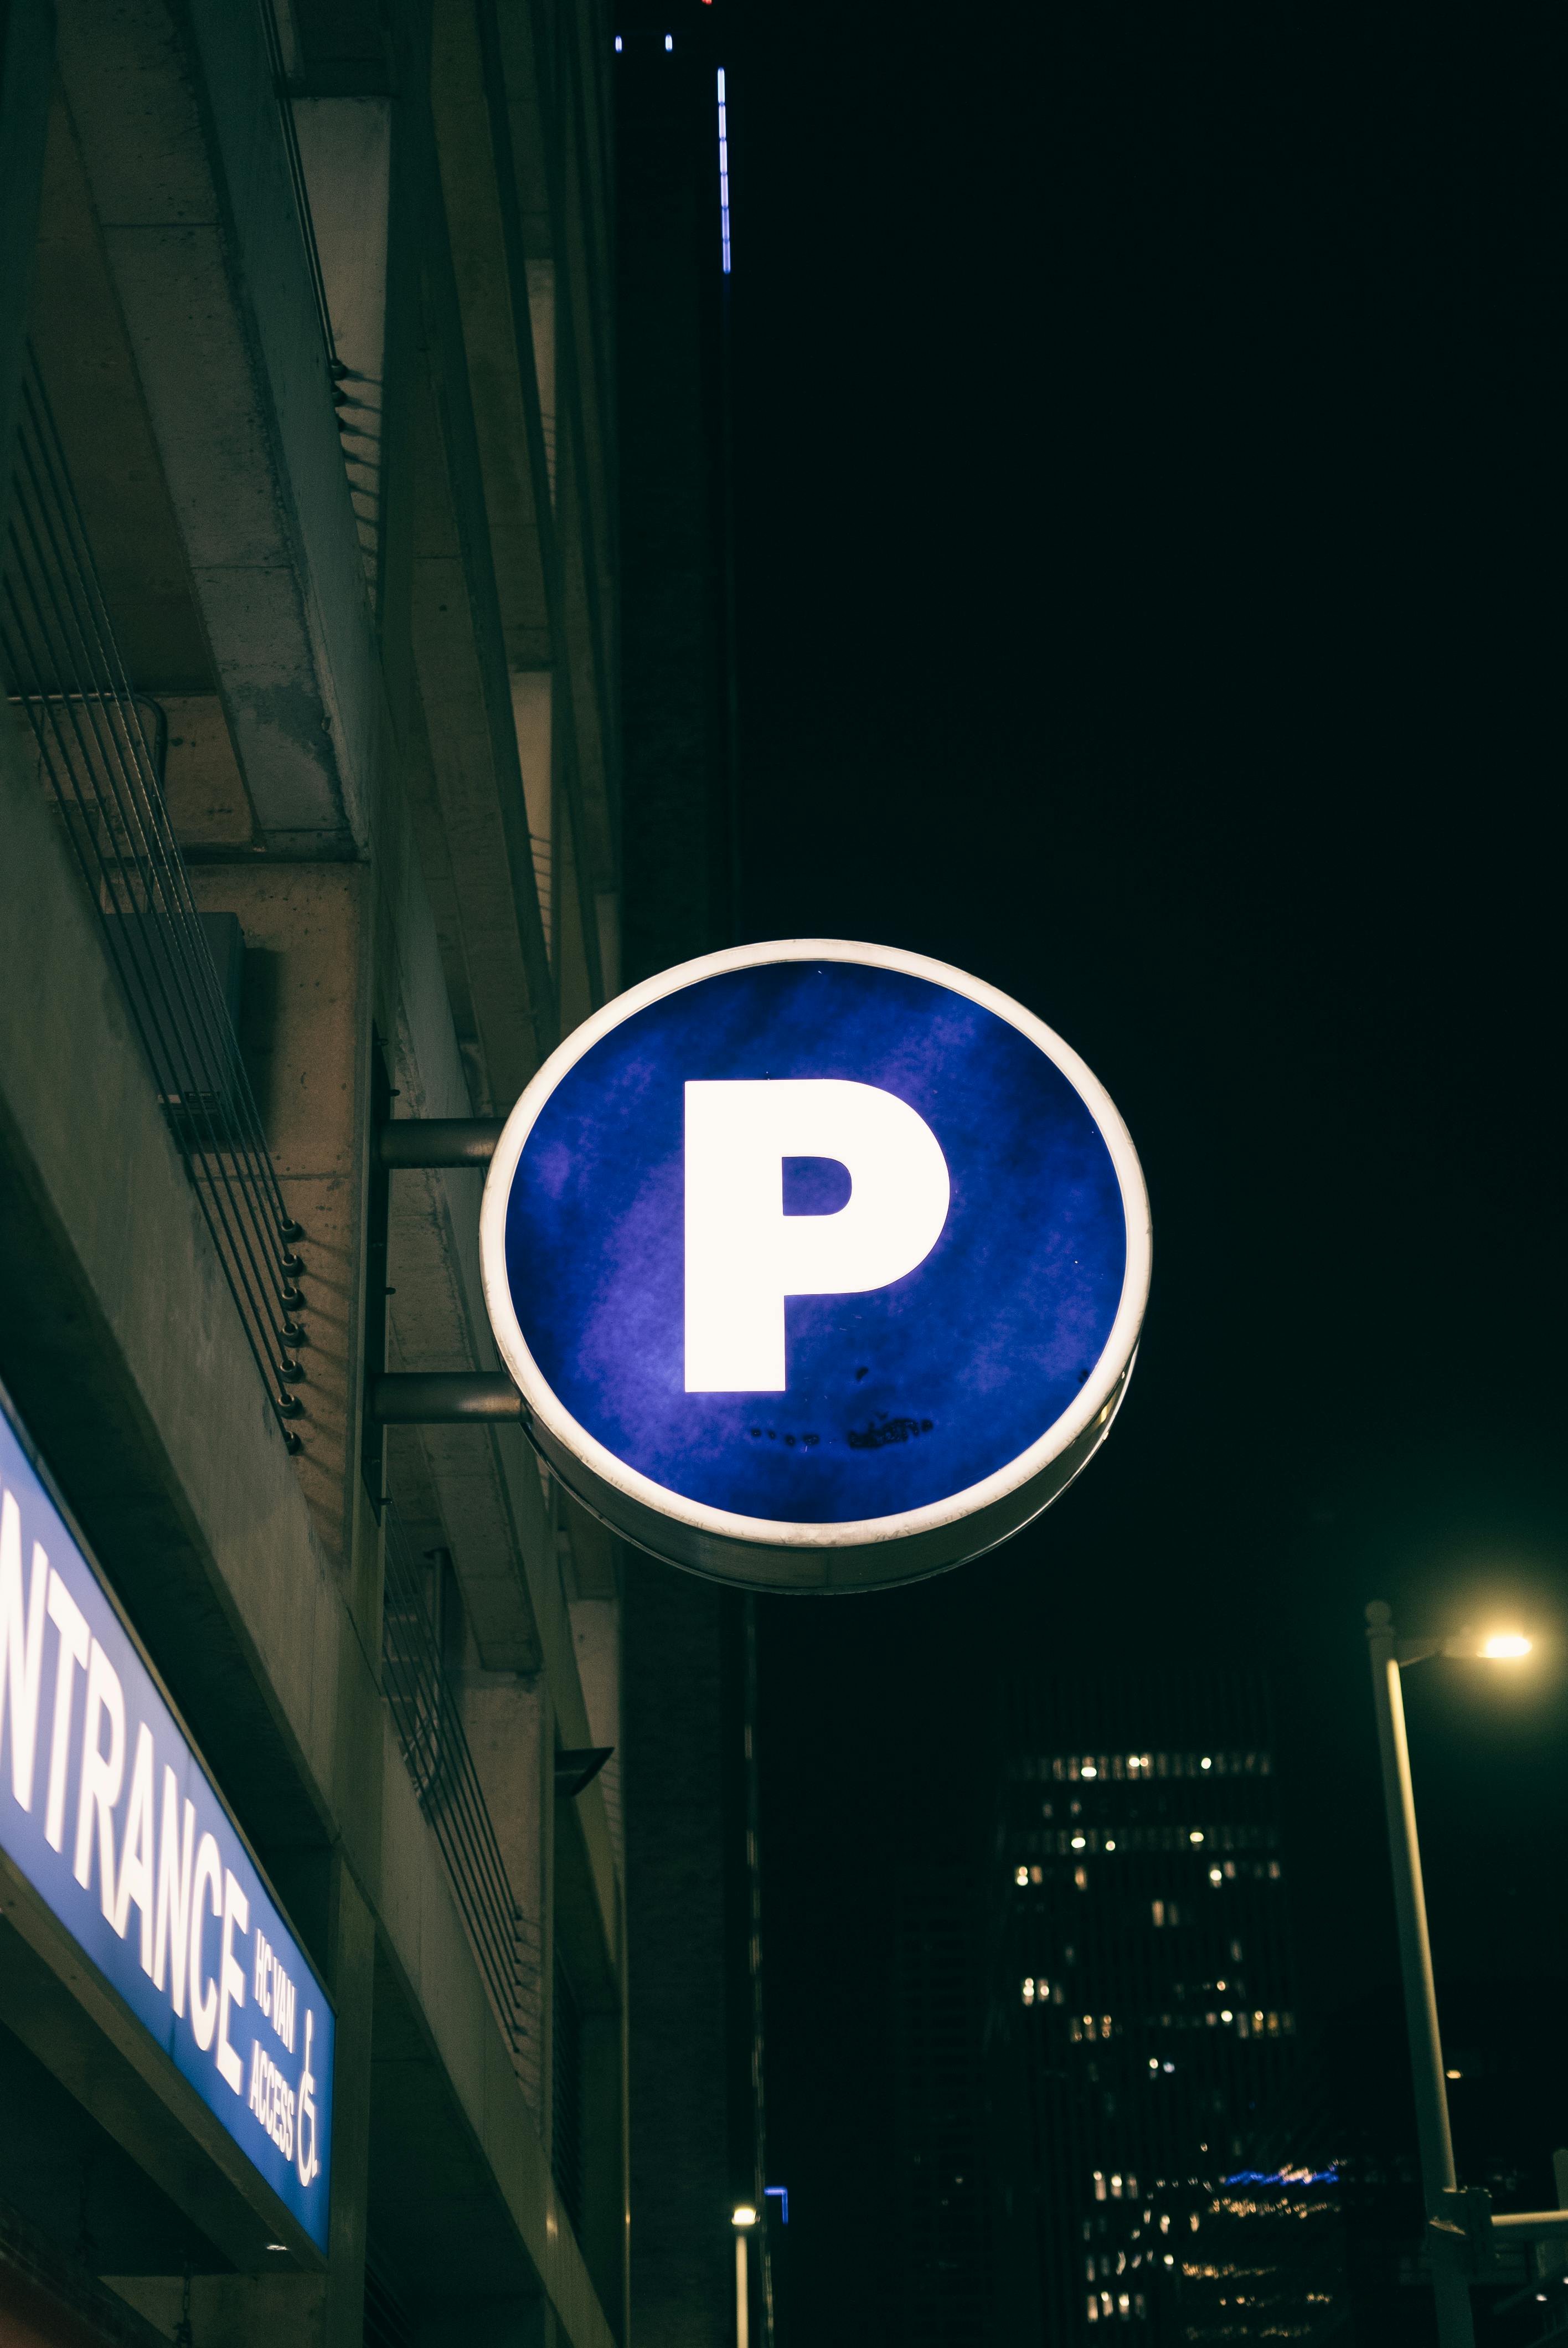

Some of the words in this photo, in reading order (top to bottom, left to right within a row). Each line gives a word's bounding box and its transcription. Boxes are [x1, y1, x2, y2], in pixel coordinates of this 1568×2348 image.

[684, 1079, 950, 1392] P
[255, 1928, 272, 2017] HC
[273, 1956, 295, 2054] VAN
[249, 2040, 295, 2162] ACCESS
